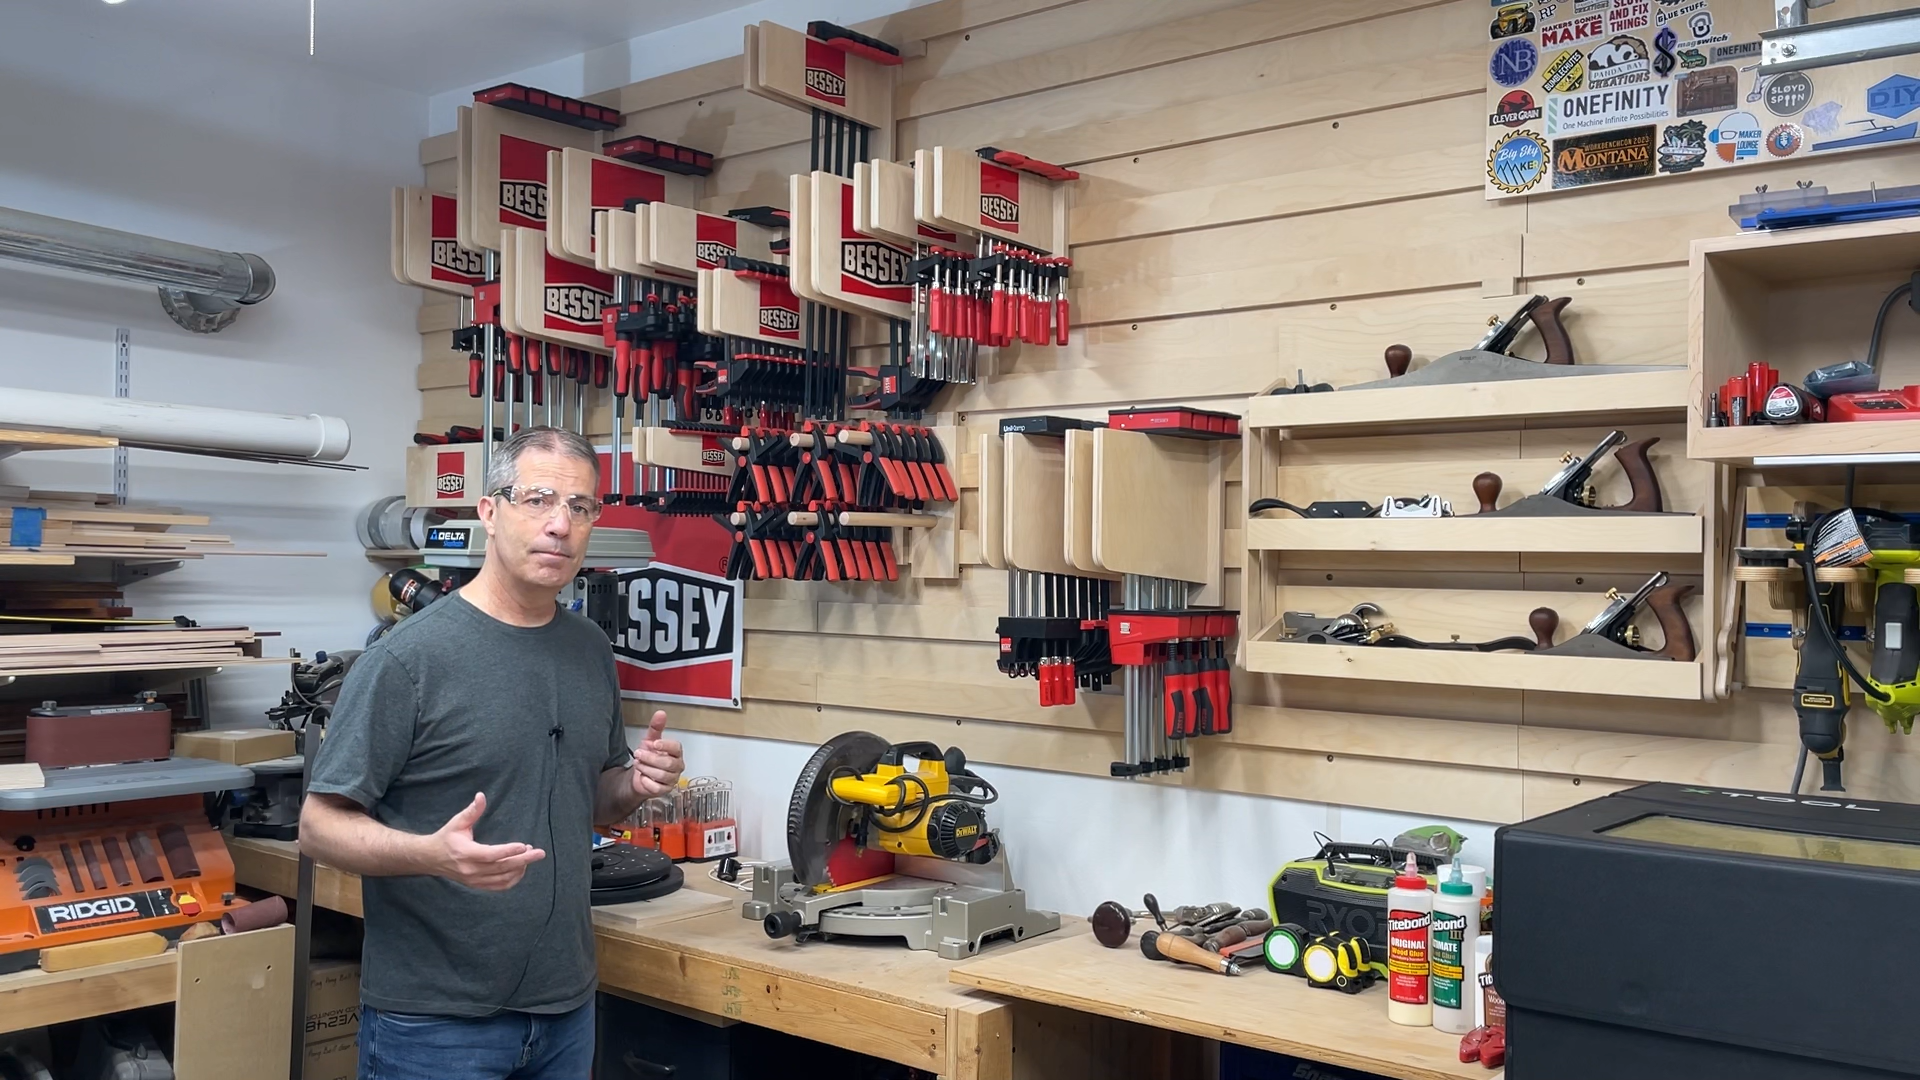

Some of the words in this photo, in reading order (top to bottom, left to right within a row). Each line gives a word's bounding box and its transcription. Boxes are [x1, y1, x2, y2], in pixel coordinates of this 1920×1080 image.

[1609, 7, 1629, 21] AND
[1632, 3, 1649, 16] FIX
[1658, 10, 1679, 23] GLUE
[1542, 20, 1573, 32] MAKERS
[1574, 14, 1602, 25] GONNA
[1610, 15, 1648, 32] THINGS
[1542, 20, 1603, 48] MAKE
[1677, 33, 1728, 49] magswitch
[1717, 41, 1763, 57] ONEFINITY
[1499, 49, 1532, 76] NB
[1547, 55, 1567, 75] TEAM
[1593, 67, 1623, 79] PANDA
[1626, 61, 1643, 71] BAY
[807, 70, 845, 95] BESSEY
[1588, 72, 1651, 90] CREATIONS
[1563, 84, 1669, 118] ONEFINITY
[1492, 112, 1518, 125] CLEVER
[1518, 109, 1540, 120] GRAIN
[1562, 122, 1576, 130] One
[1577, 118, 1604, 129] Machine
[1605, 115, 1628, 124] Infinite
[1629, 109, 1669, 121] Possibilities
[1738, 130, 1762, 139] MAKER
[1498, 148, 1518, 161] Big
[1519, 144, 1539, 158] Sky
[1559, 146, 1650, 171] MONTANA
[502, 183, 547, 217] BESS
[981, 196, 1019, 221] BESSEY
[760, 308, 799, 331] BESSEY
[702, 448, 726, 462] BESSEY
[437, 474, 465, 492] BESSEY
[438, 531, 465, 541] DELTA
[617, 577, 729, 654] SSEY
[956, 824, 978, 838] DEWALT
[48, 896, 136, 923] RIDGID
[1389, 913, 1431, 931] Titebond
[1433, 917, 1465, 931] ebond
[1391, 936, 1426, 950] ORIGINAL
[1450, 930, 1462, 940] III
[1392, 946, 1408, 956] Wood
[1409, 949, 1424, 958] Glue
[306, 1008, 344, 1021] MONITOR
